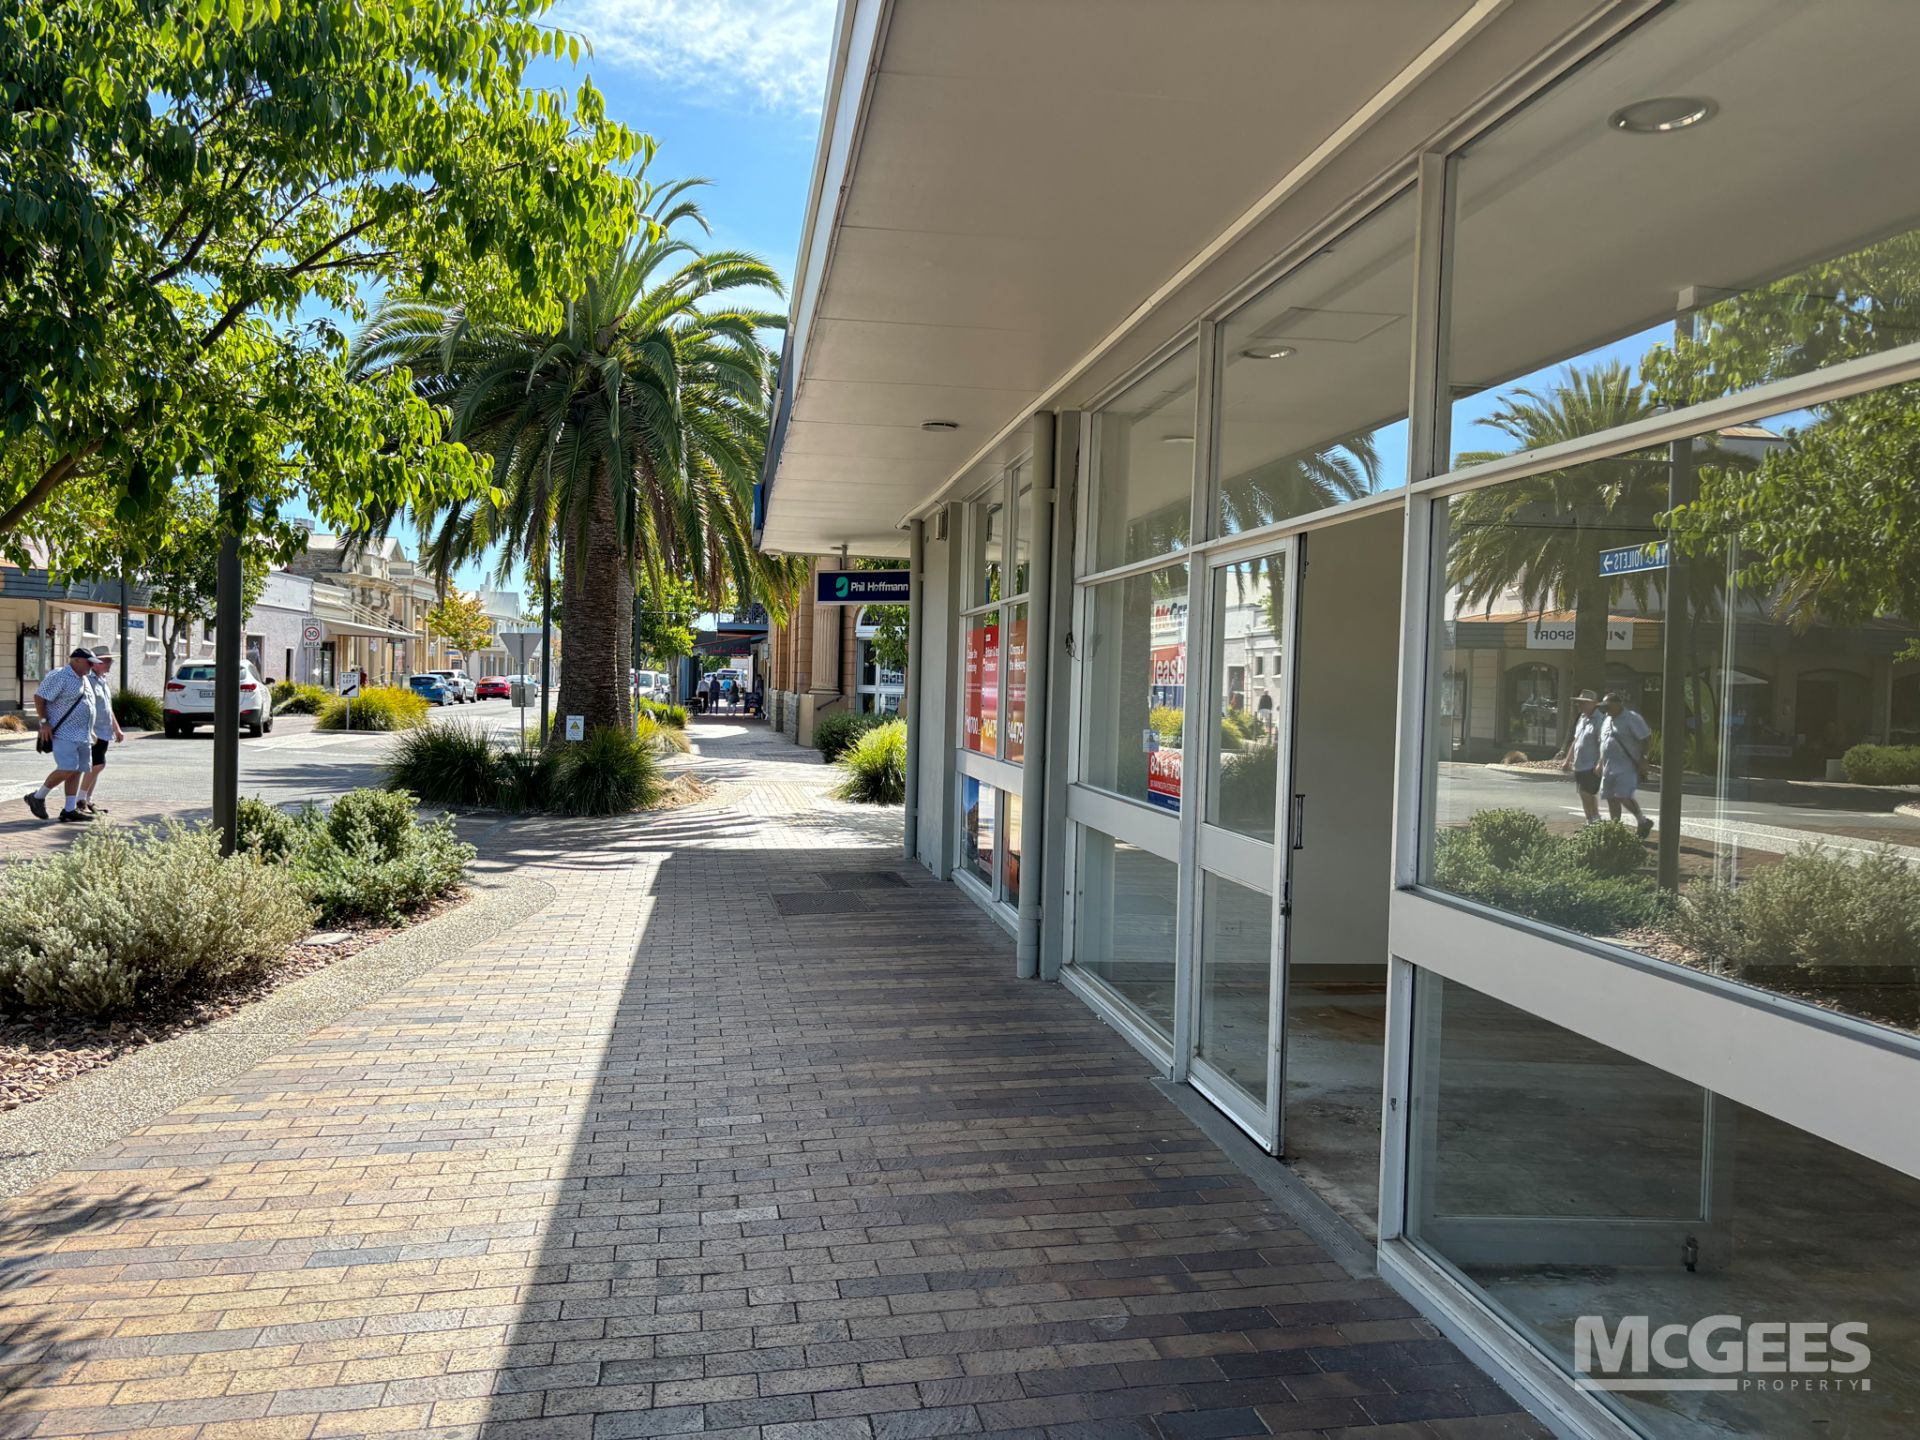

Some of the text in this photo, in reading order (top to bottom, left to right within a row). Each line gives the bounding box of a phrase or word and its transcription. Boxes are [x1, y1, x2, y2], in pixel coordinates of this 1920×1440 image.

[850, 582, 909, 592] Phil Hoffmann
[1153, 652, 1185, 684] lease
